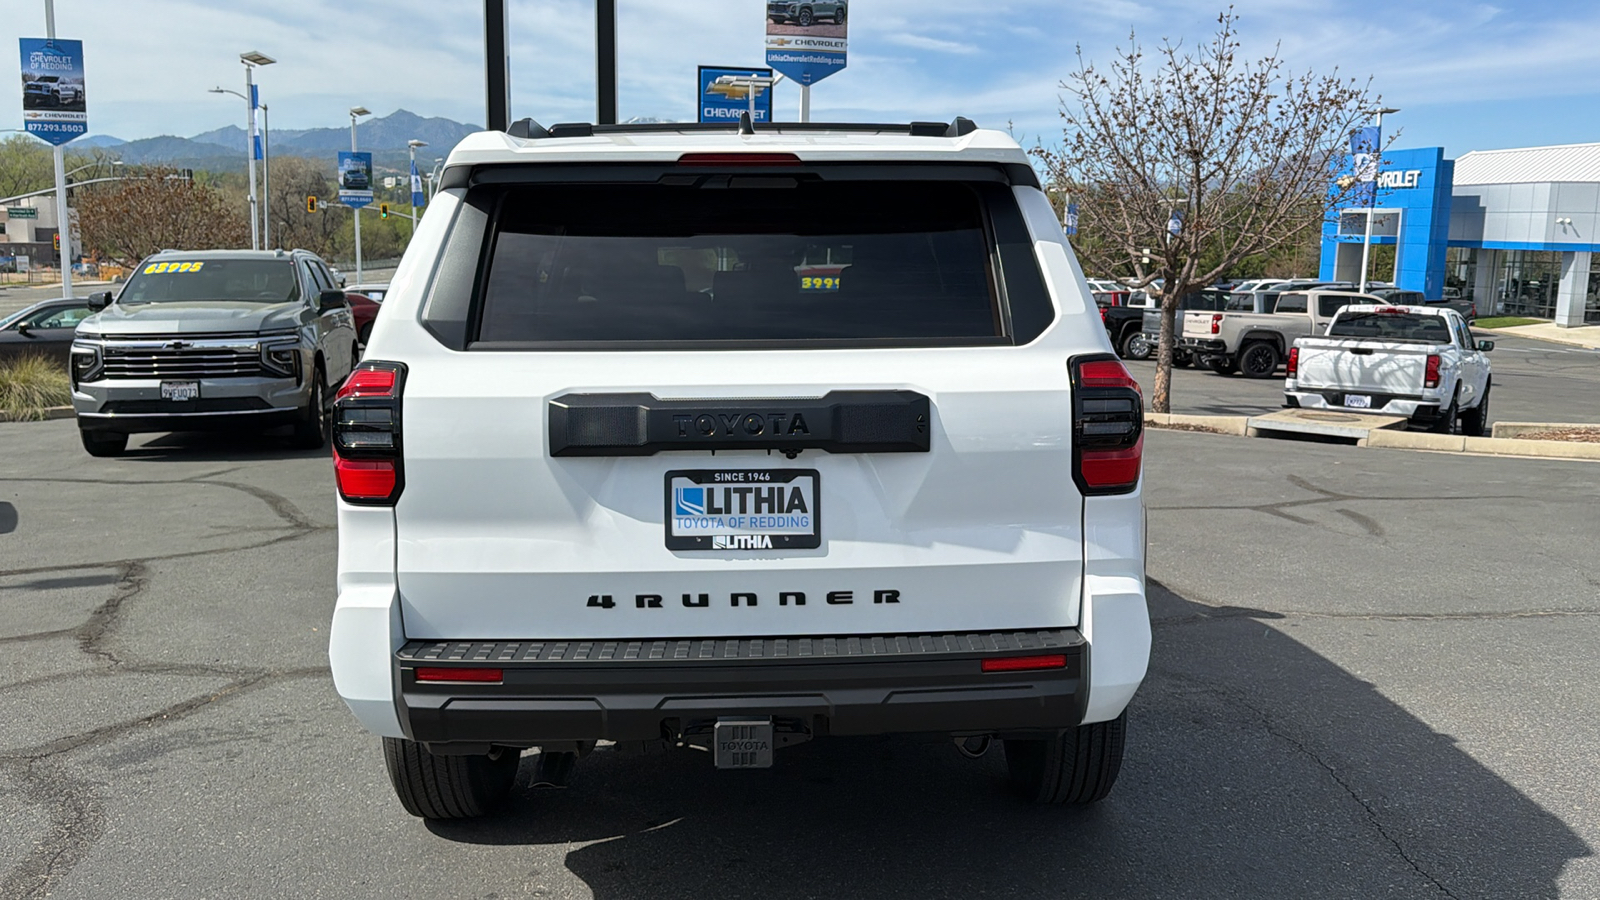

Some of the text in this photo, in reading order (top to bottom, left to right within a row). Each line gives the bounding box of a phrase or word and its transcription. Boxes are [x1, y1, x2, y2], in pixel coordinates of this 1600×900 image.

[794, 39, 845, 48] CHEVROLET
[30, 55, 72, 63] CHEVROLET
[767, 54, 845, 65] LithiaChevroletRedding.com
[41, 62, 73, 70] REDDING
[704, 107, 766, 119] CHEVRET
[27, 123, 84, 132] 877.293.5503
[1377, 169, 1421, 188] VROLET
[144, 262, 204, 274] 63995
[672, 413, 811, 438] TOYOTA
[714, 472, 771, 482] SINCE 1946
[706, 486, 809, 515] LITHIA
[675, 515, 809, 529] TOYOTA OF REDDING
[725, 534, 773, 549] LITHIA
[586, 589, 901, 609] 4RUNNER
[720, 741, 769, 752] TOYOTA
